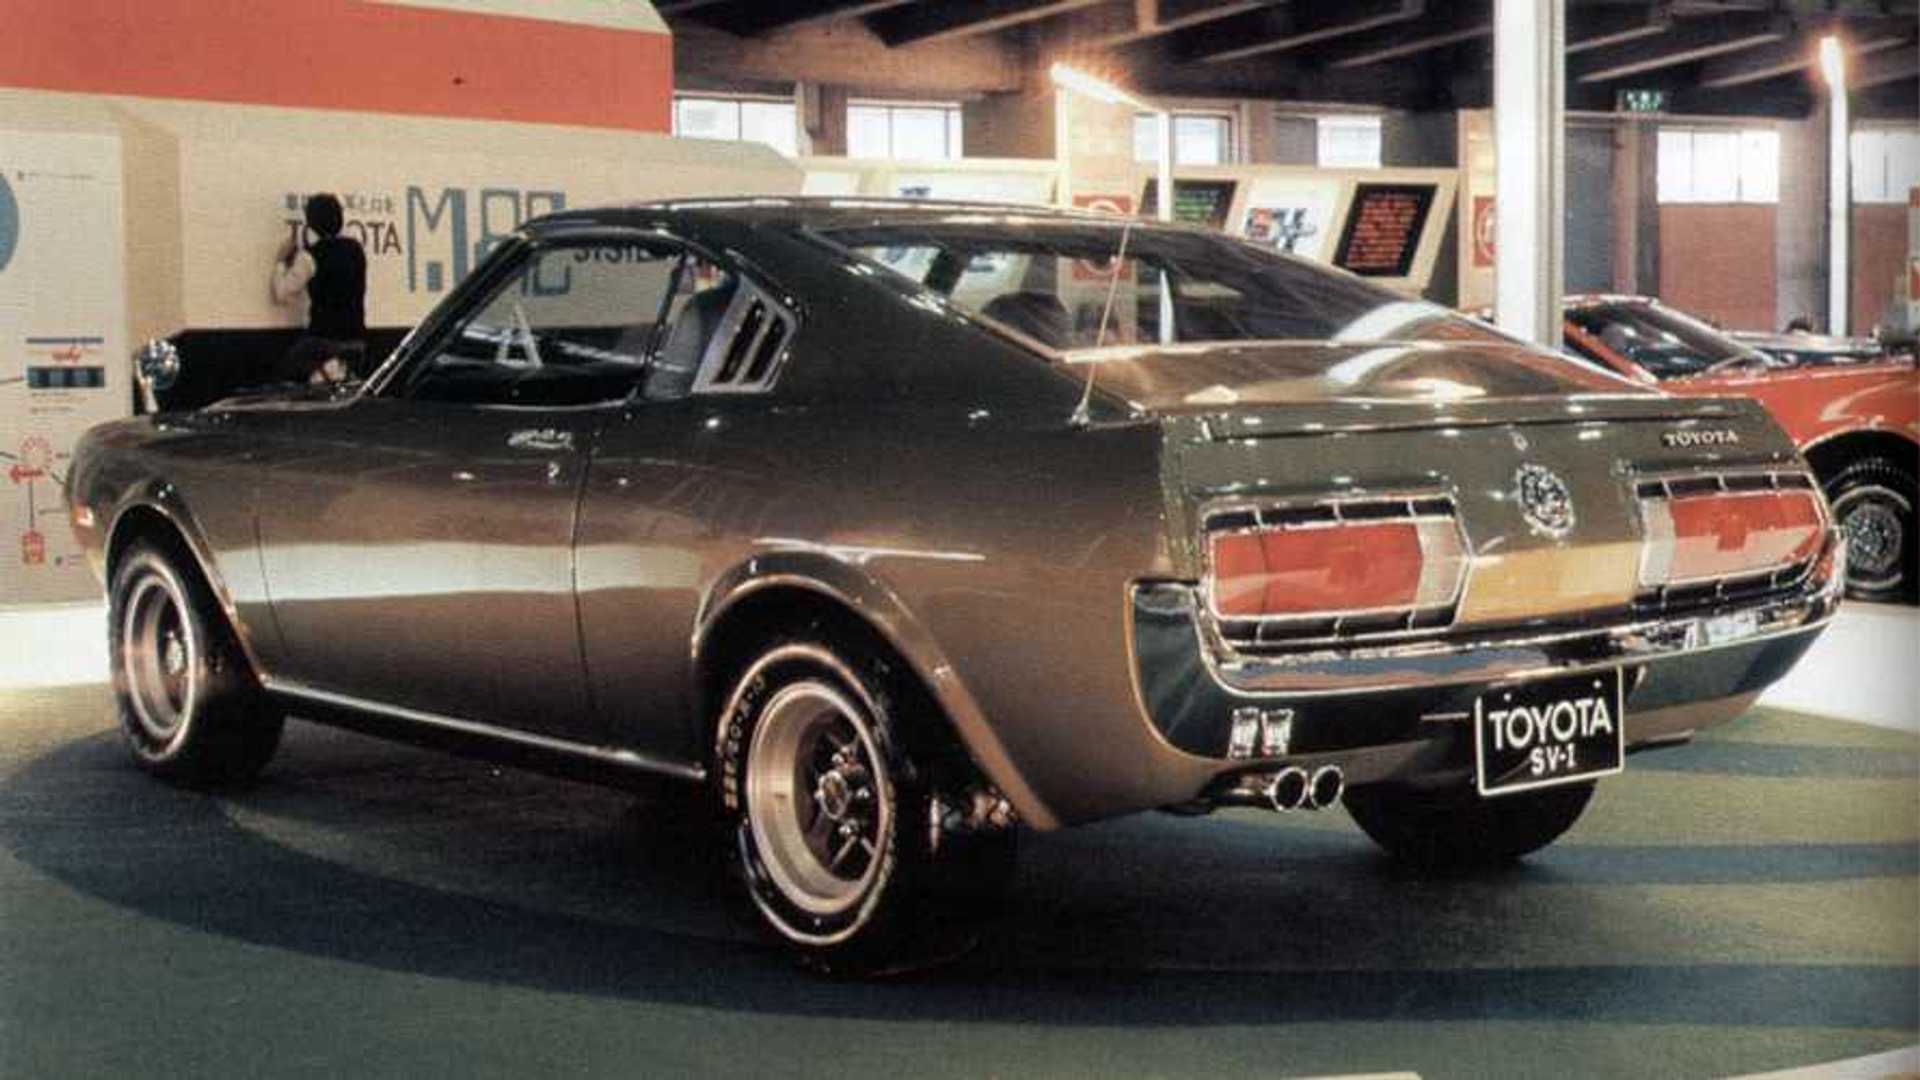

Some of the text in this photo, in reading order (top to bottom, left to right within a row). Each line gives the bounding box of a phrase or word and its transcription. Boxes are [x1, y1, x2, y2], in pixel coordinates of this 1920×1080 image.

[1663, 430, 1739, 447] TOYOTA
[1488, 698, 1613, 750] TOYOTA
[1530, 743, 1577, 775] SV-1
